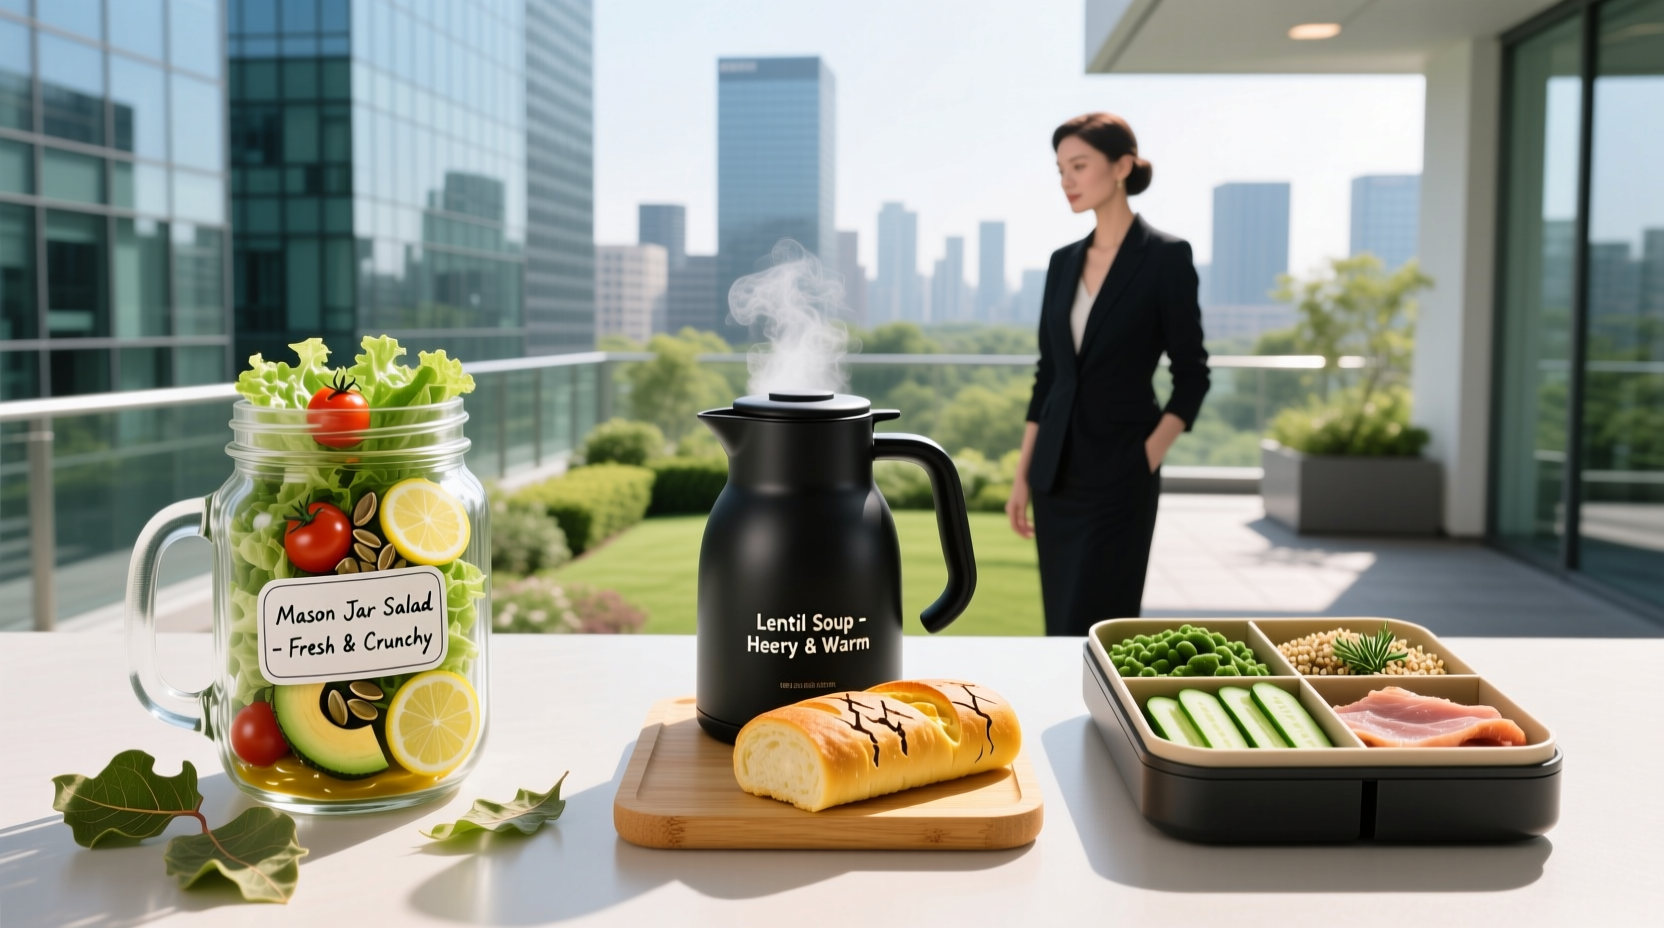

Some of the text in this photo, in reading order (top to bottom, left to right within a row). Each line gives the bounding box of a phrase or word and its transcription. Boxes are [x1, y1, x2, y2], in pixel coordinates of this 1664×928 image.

[275, 590, 434, 626] Mason Jar Salad
[756, 612, 806, 632] Lentil
[812, 613, 854, 635] Soup
[289, 635, 335, 658] Fresh
[343, 633, 356, 653] &
[364, 626, 433, 655] Crunchy
[747, 634, 870, 659] Heery & Warm
